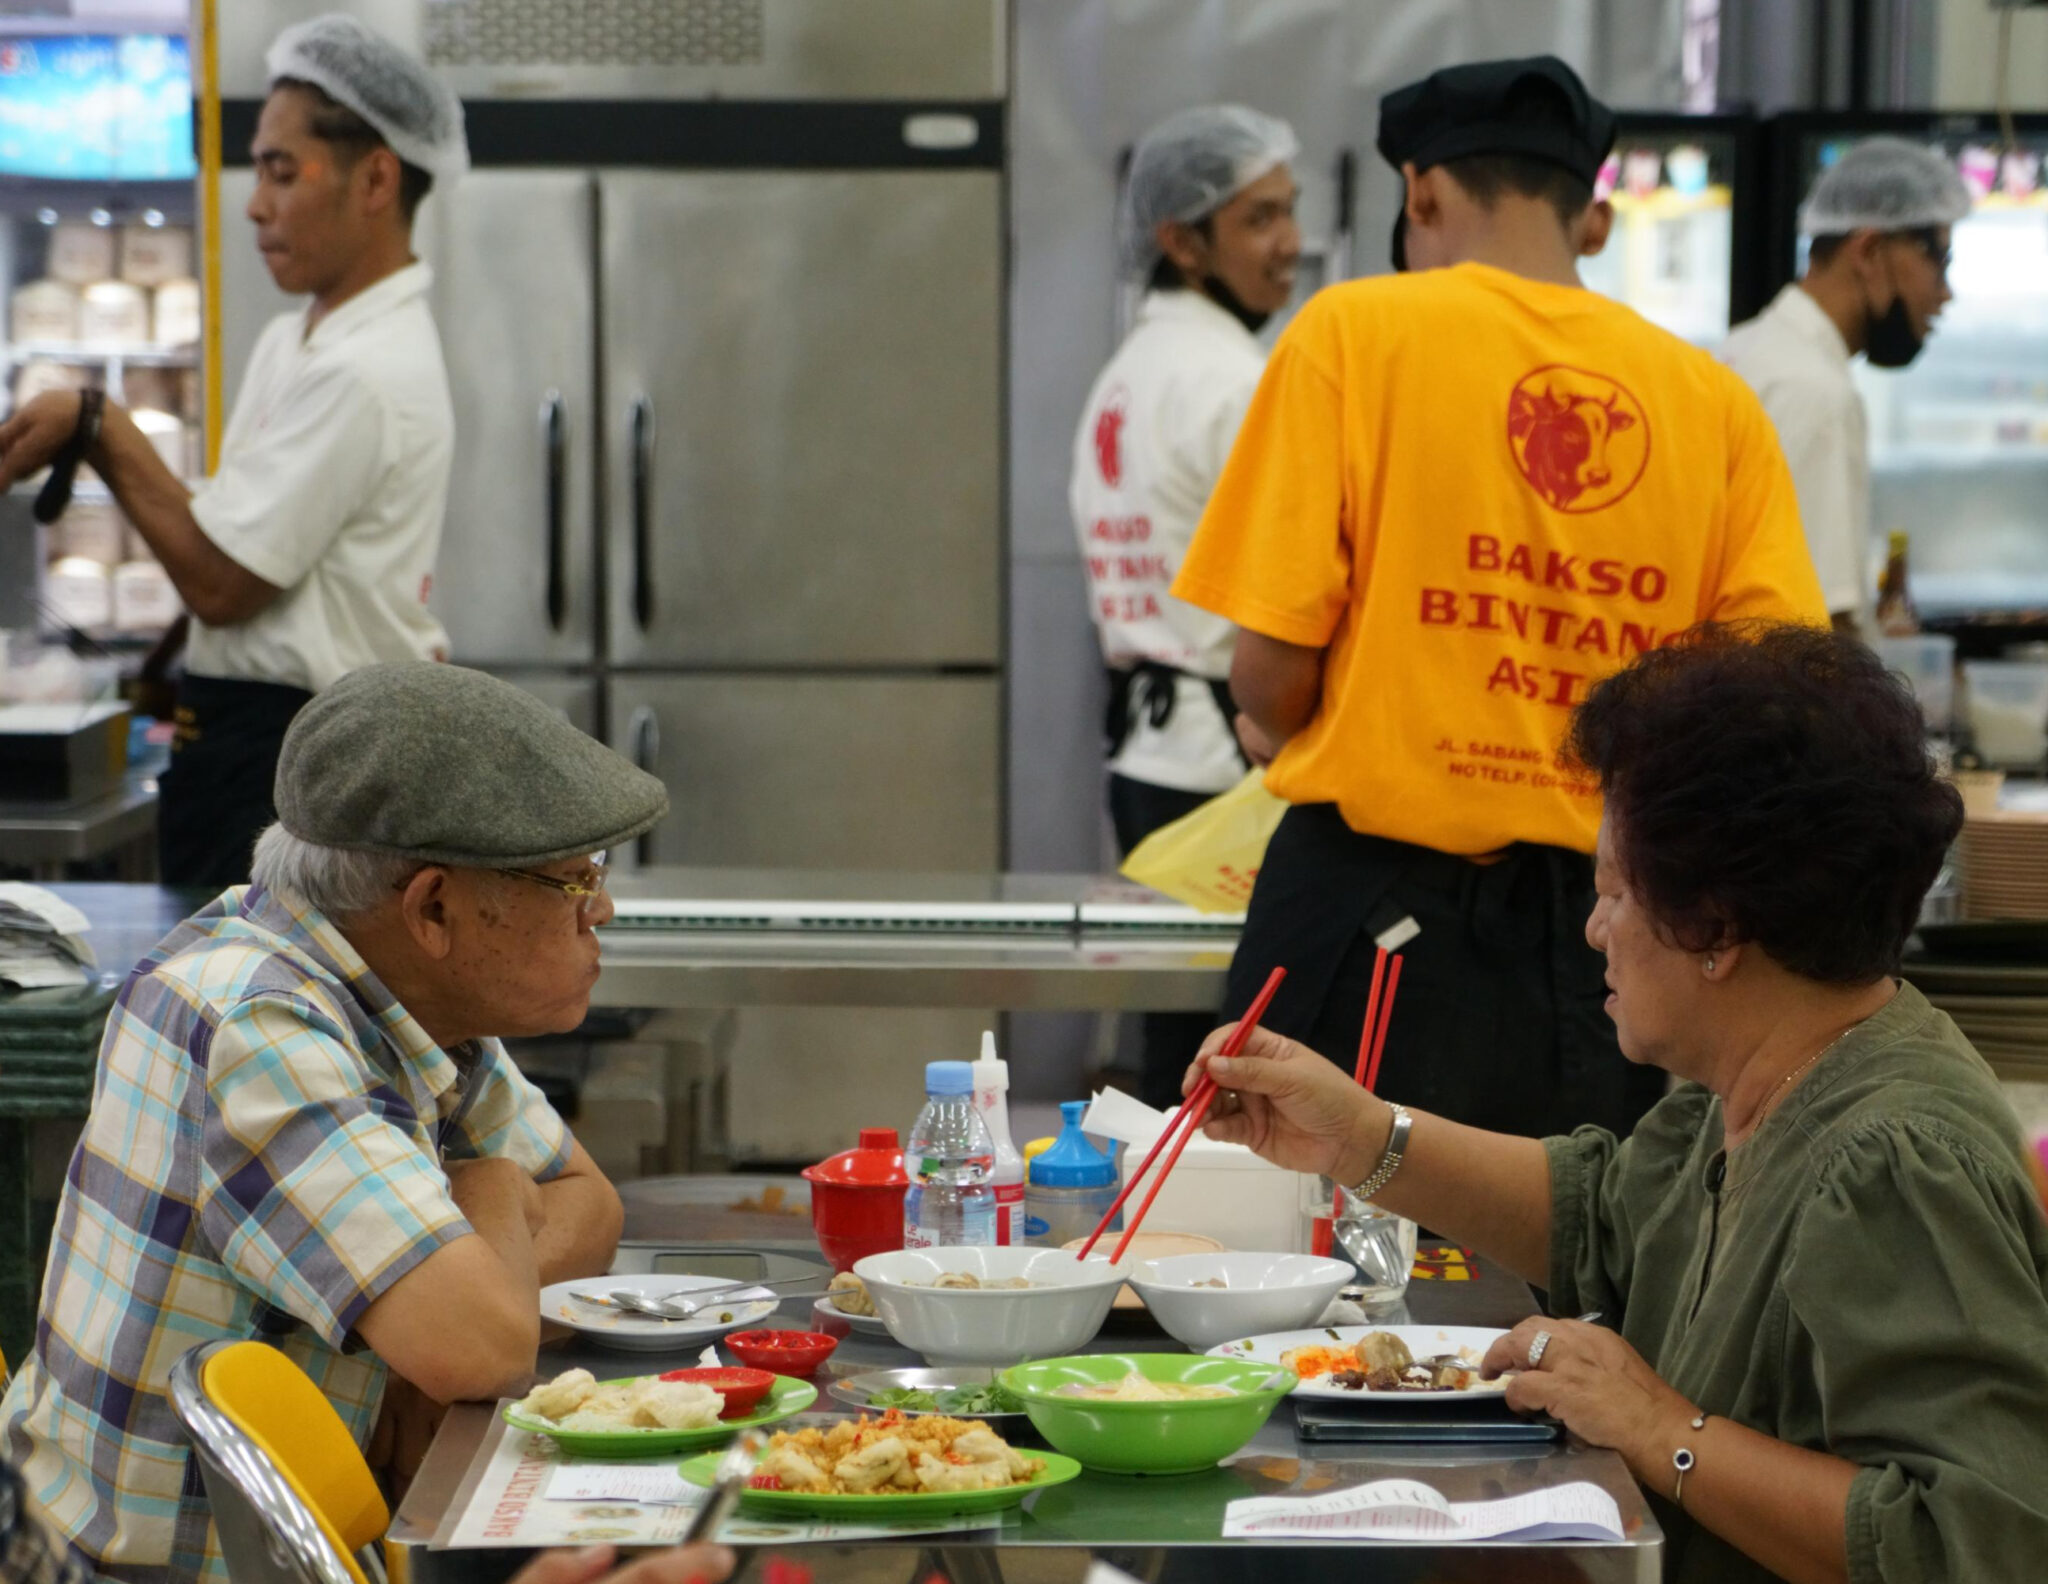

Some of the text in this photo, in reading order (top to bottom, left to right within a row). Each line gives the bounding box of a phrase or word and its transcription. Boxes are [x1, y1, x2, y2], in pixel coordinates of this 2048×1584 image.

[1467, 533, 1668, 604] BAKSO
[1486, 656, 1588, 708] ASI
[1449, 762, 1476, 779] NO
[1468, 742, 1542, 765] SABANG
